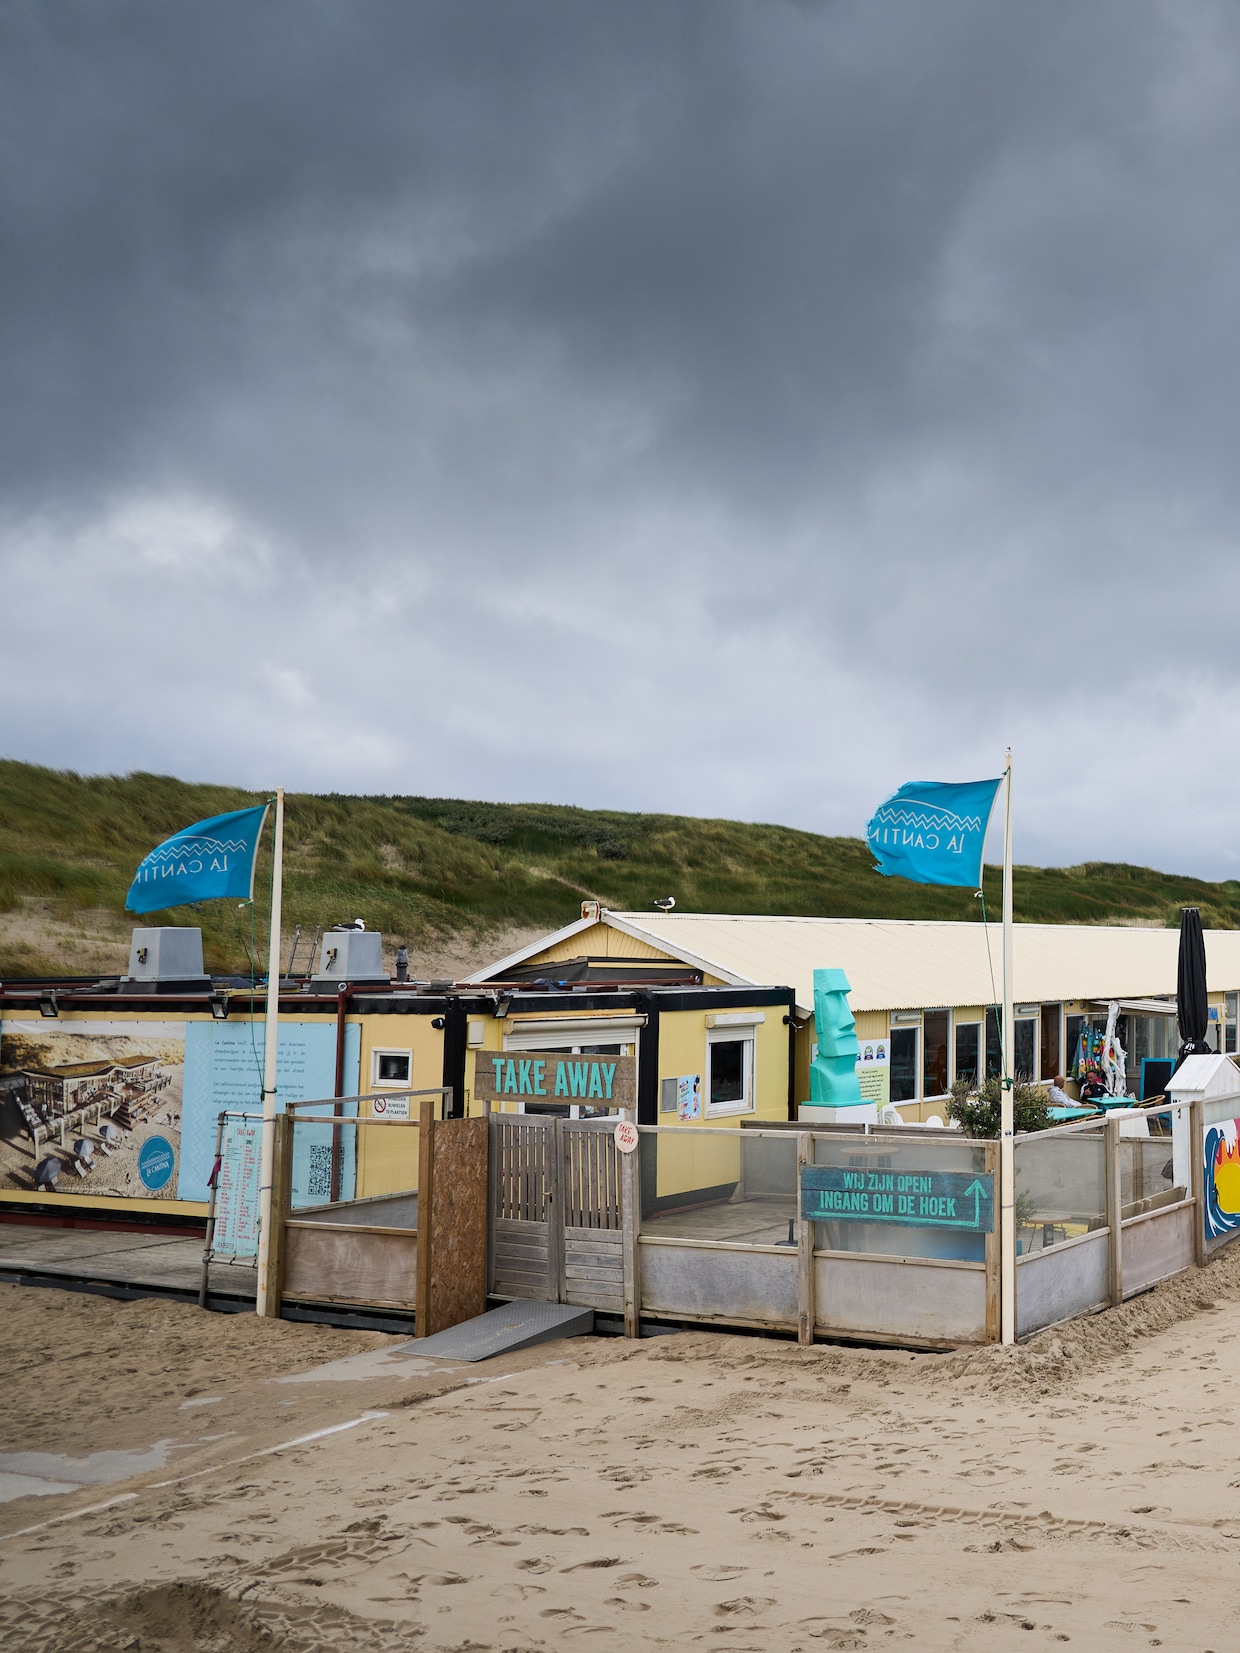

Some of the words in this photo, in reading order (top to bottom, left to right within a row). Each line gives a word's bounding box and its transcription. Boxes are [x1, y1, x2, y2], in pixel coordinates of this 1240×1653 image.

[492, 1058, 547, 1096] TAKE
[555, 1061, 617, 1099] AWAY
[619, 1124, 632, 1134] TAKE
[843, 1173, 865, 1190] WIJ
[868, 1173, 894, 1191] ZIJN
[897, 1175, 932, 1194] OPEN!
[820, 1190, 869, 1212] INGANG
[872, 1194, 894, 1213] OM
[898, 1195, 916, 1215] DE
[919, 1197, 956, 1217] HOEK
